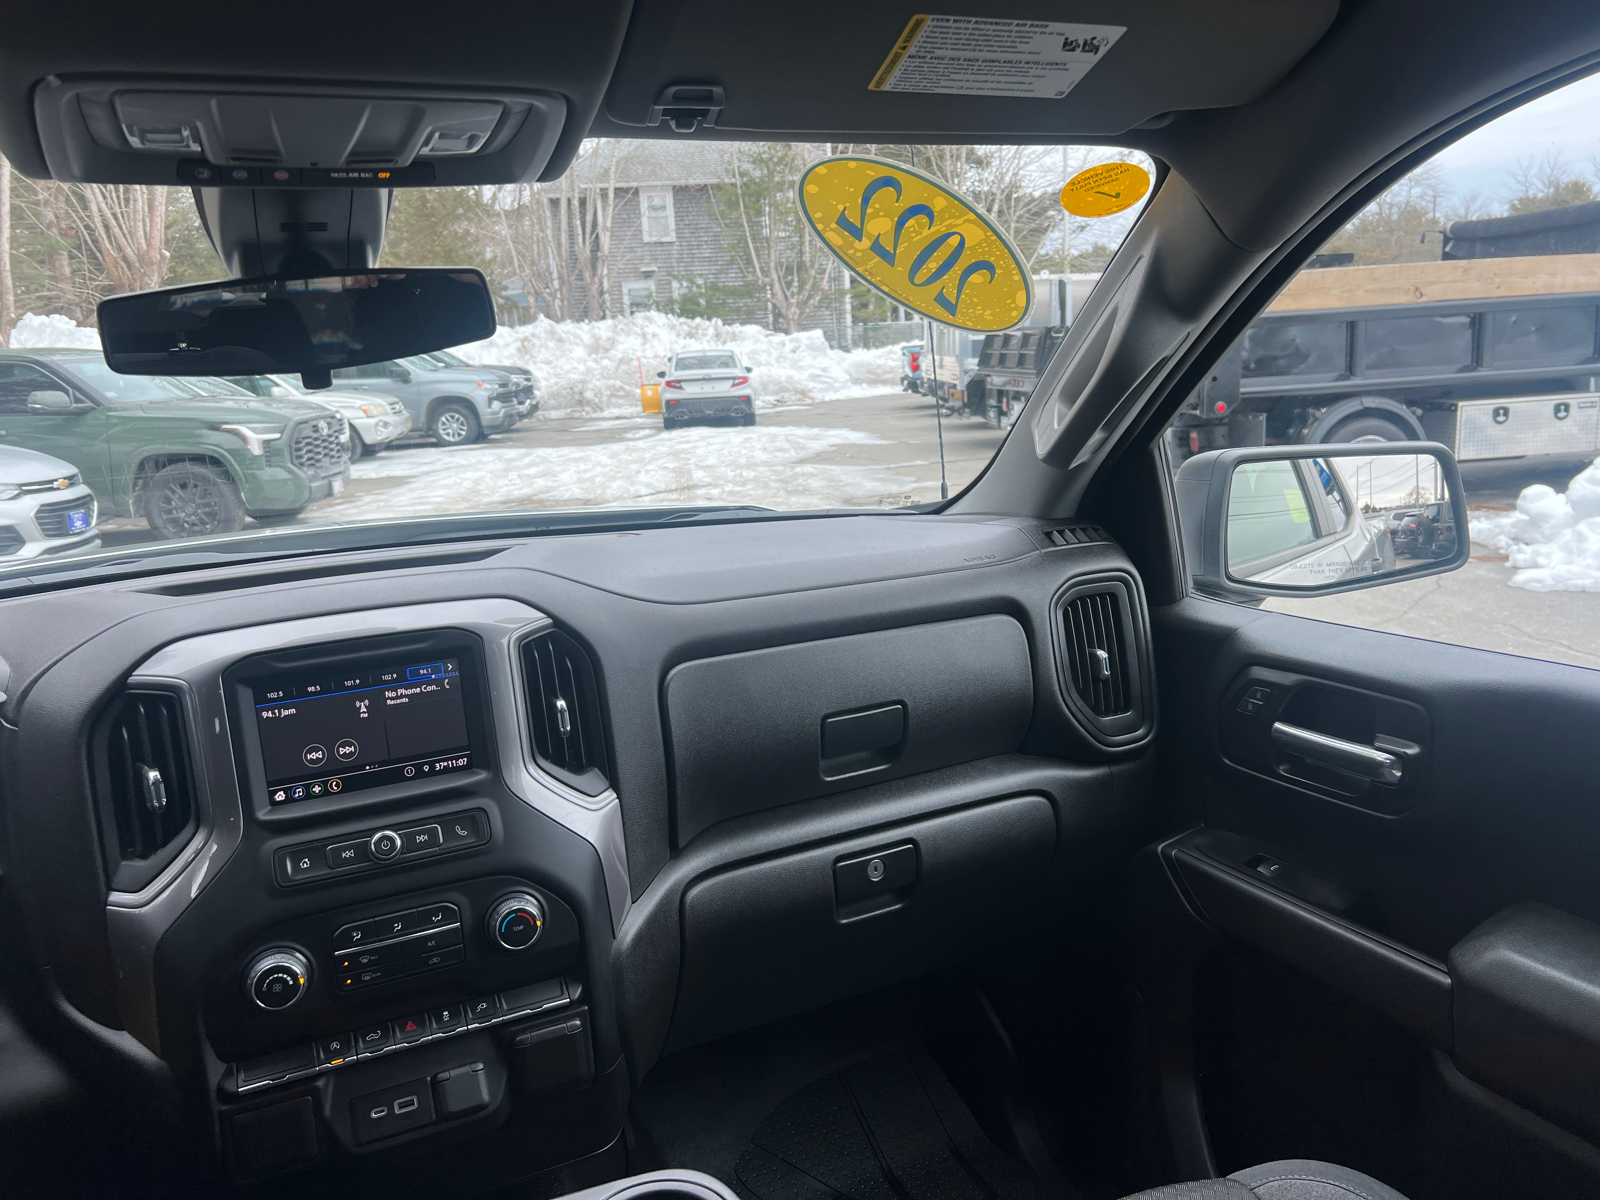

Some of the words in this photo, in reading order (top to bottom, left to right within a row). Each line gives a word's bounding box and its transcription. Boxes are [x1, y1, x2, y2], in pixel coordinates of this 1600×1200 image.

[381, 673, 397, 681] 102.9
[344, 679, 360, 687] 101.9
[266, 690, 283, 699] 102.5
[385, 689, 396, 698] No
[398, 684, 421, 698] Phone
[386, 697, 409, 705] Recents
[261, 709, 279, 719] 94.1
[280, 707, 296, 718] Jam
